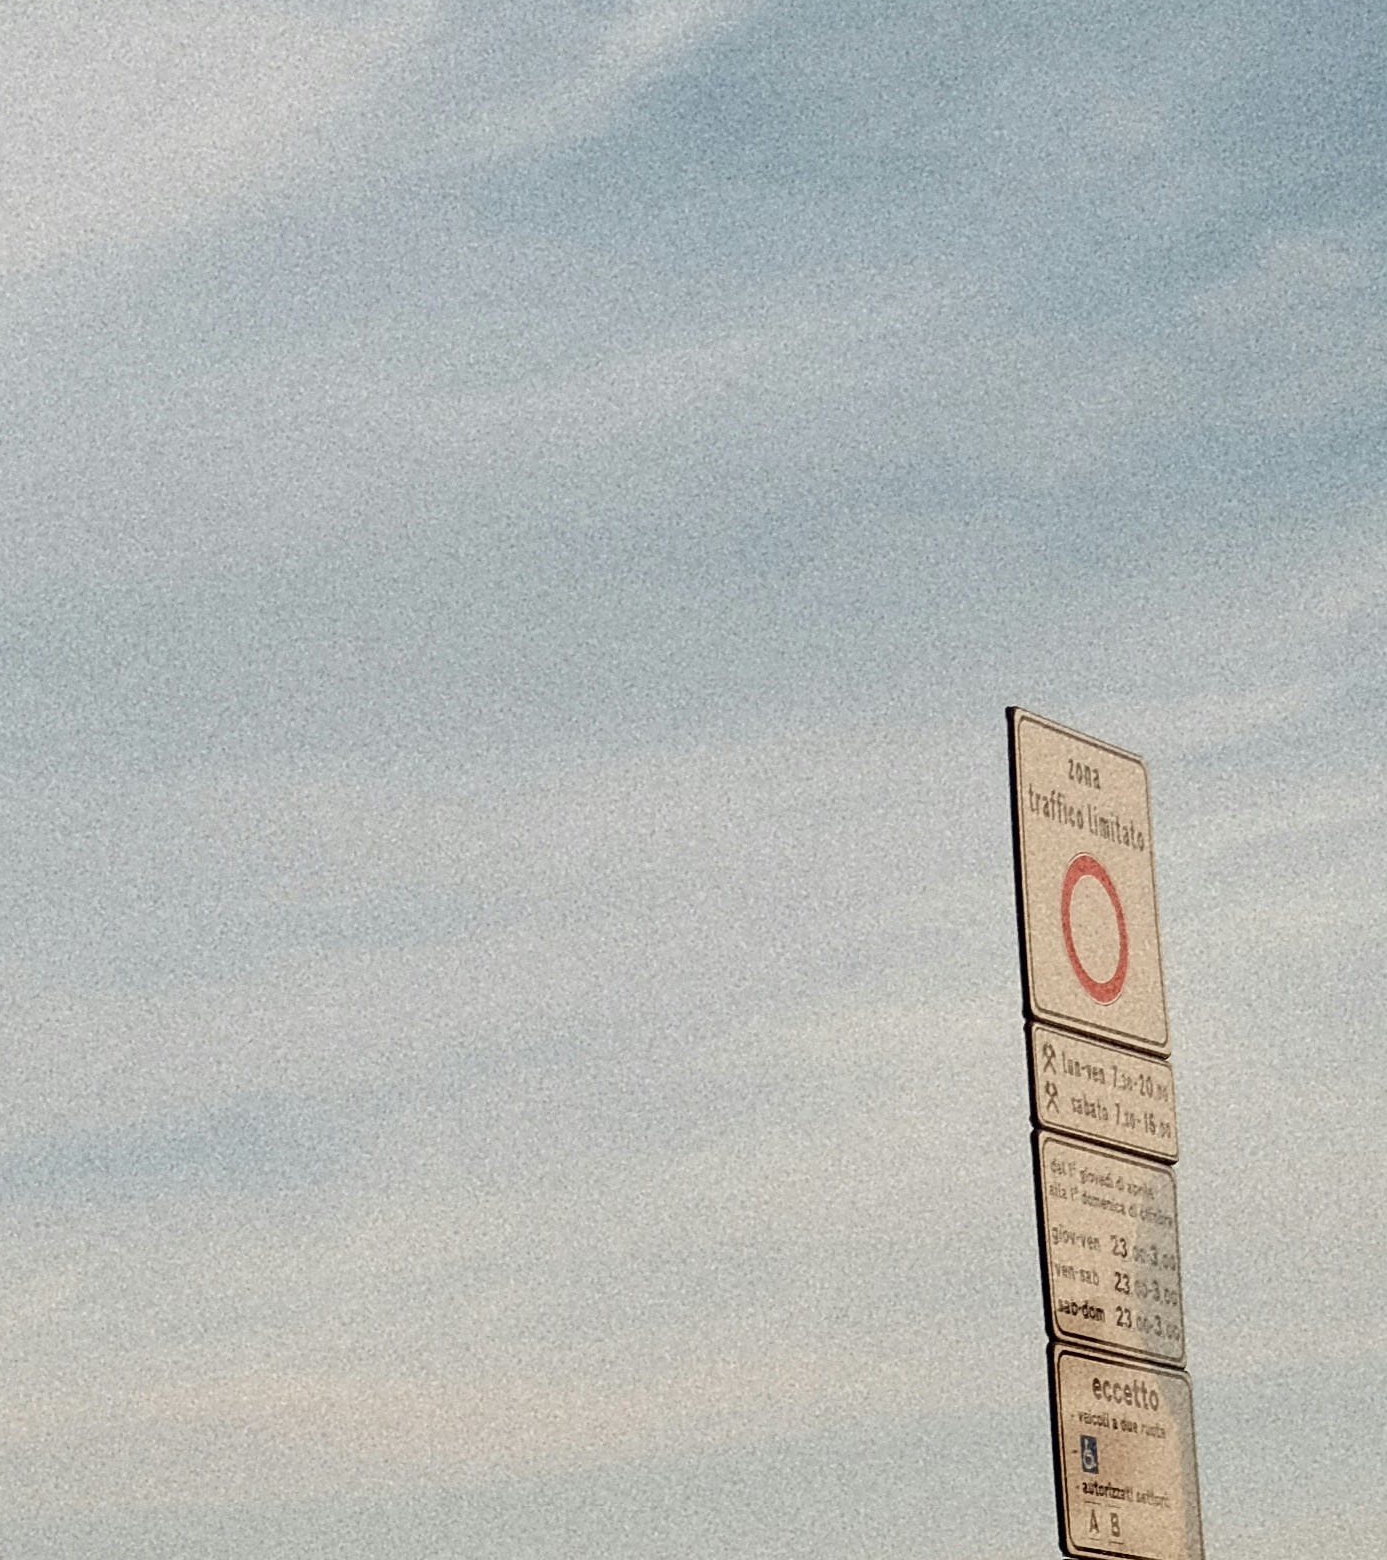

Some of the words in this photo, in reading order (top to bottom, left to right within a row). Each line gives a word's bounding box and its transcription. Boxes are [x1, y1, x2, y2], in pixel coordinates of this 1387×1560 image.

[1068, 758, 1101, 789] zona
[1028, 783, 1084, 830] traffico
[1087, 803, 1145, 851] limitato
[1071, 1092, 1109, 1121] sabato
[1051, 1224, 1101, 1252] giov-ven
[1054, 1263, 1100, 1286] ven-sab
[1057, 1298, 1106, 1323] sab-dom
[1092, 1377, 1160, 1412] eccetto
[1077, 1410, 1109, 1428] veicoli
[1111, 1417, 1119, 1430] a
[1082, 1481, 1133, 1503] autorizzati
[1089, 1509, 1099, 1534] A
[1110, 1512, 1121, 1538] B
